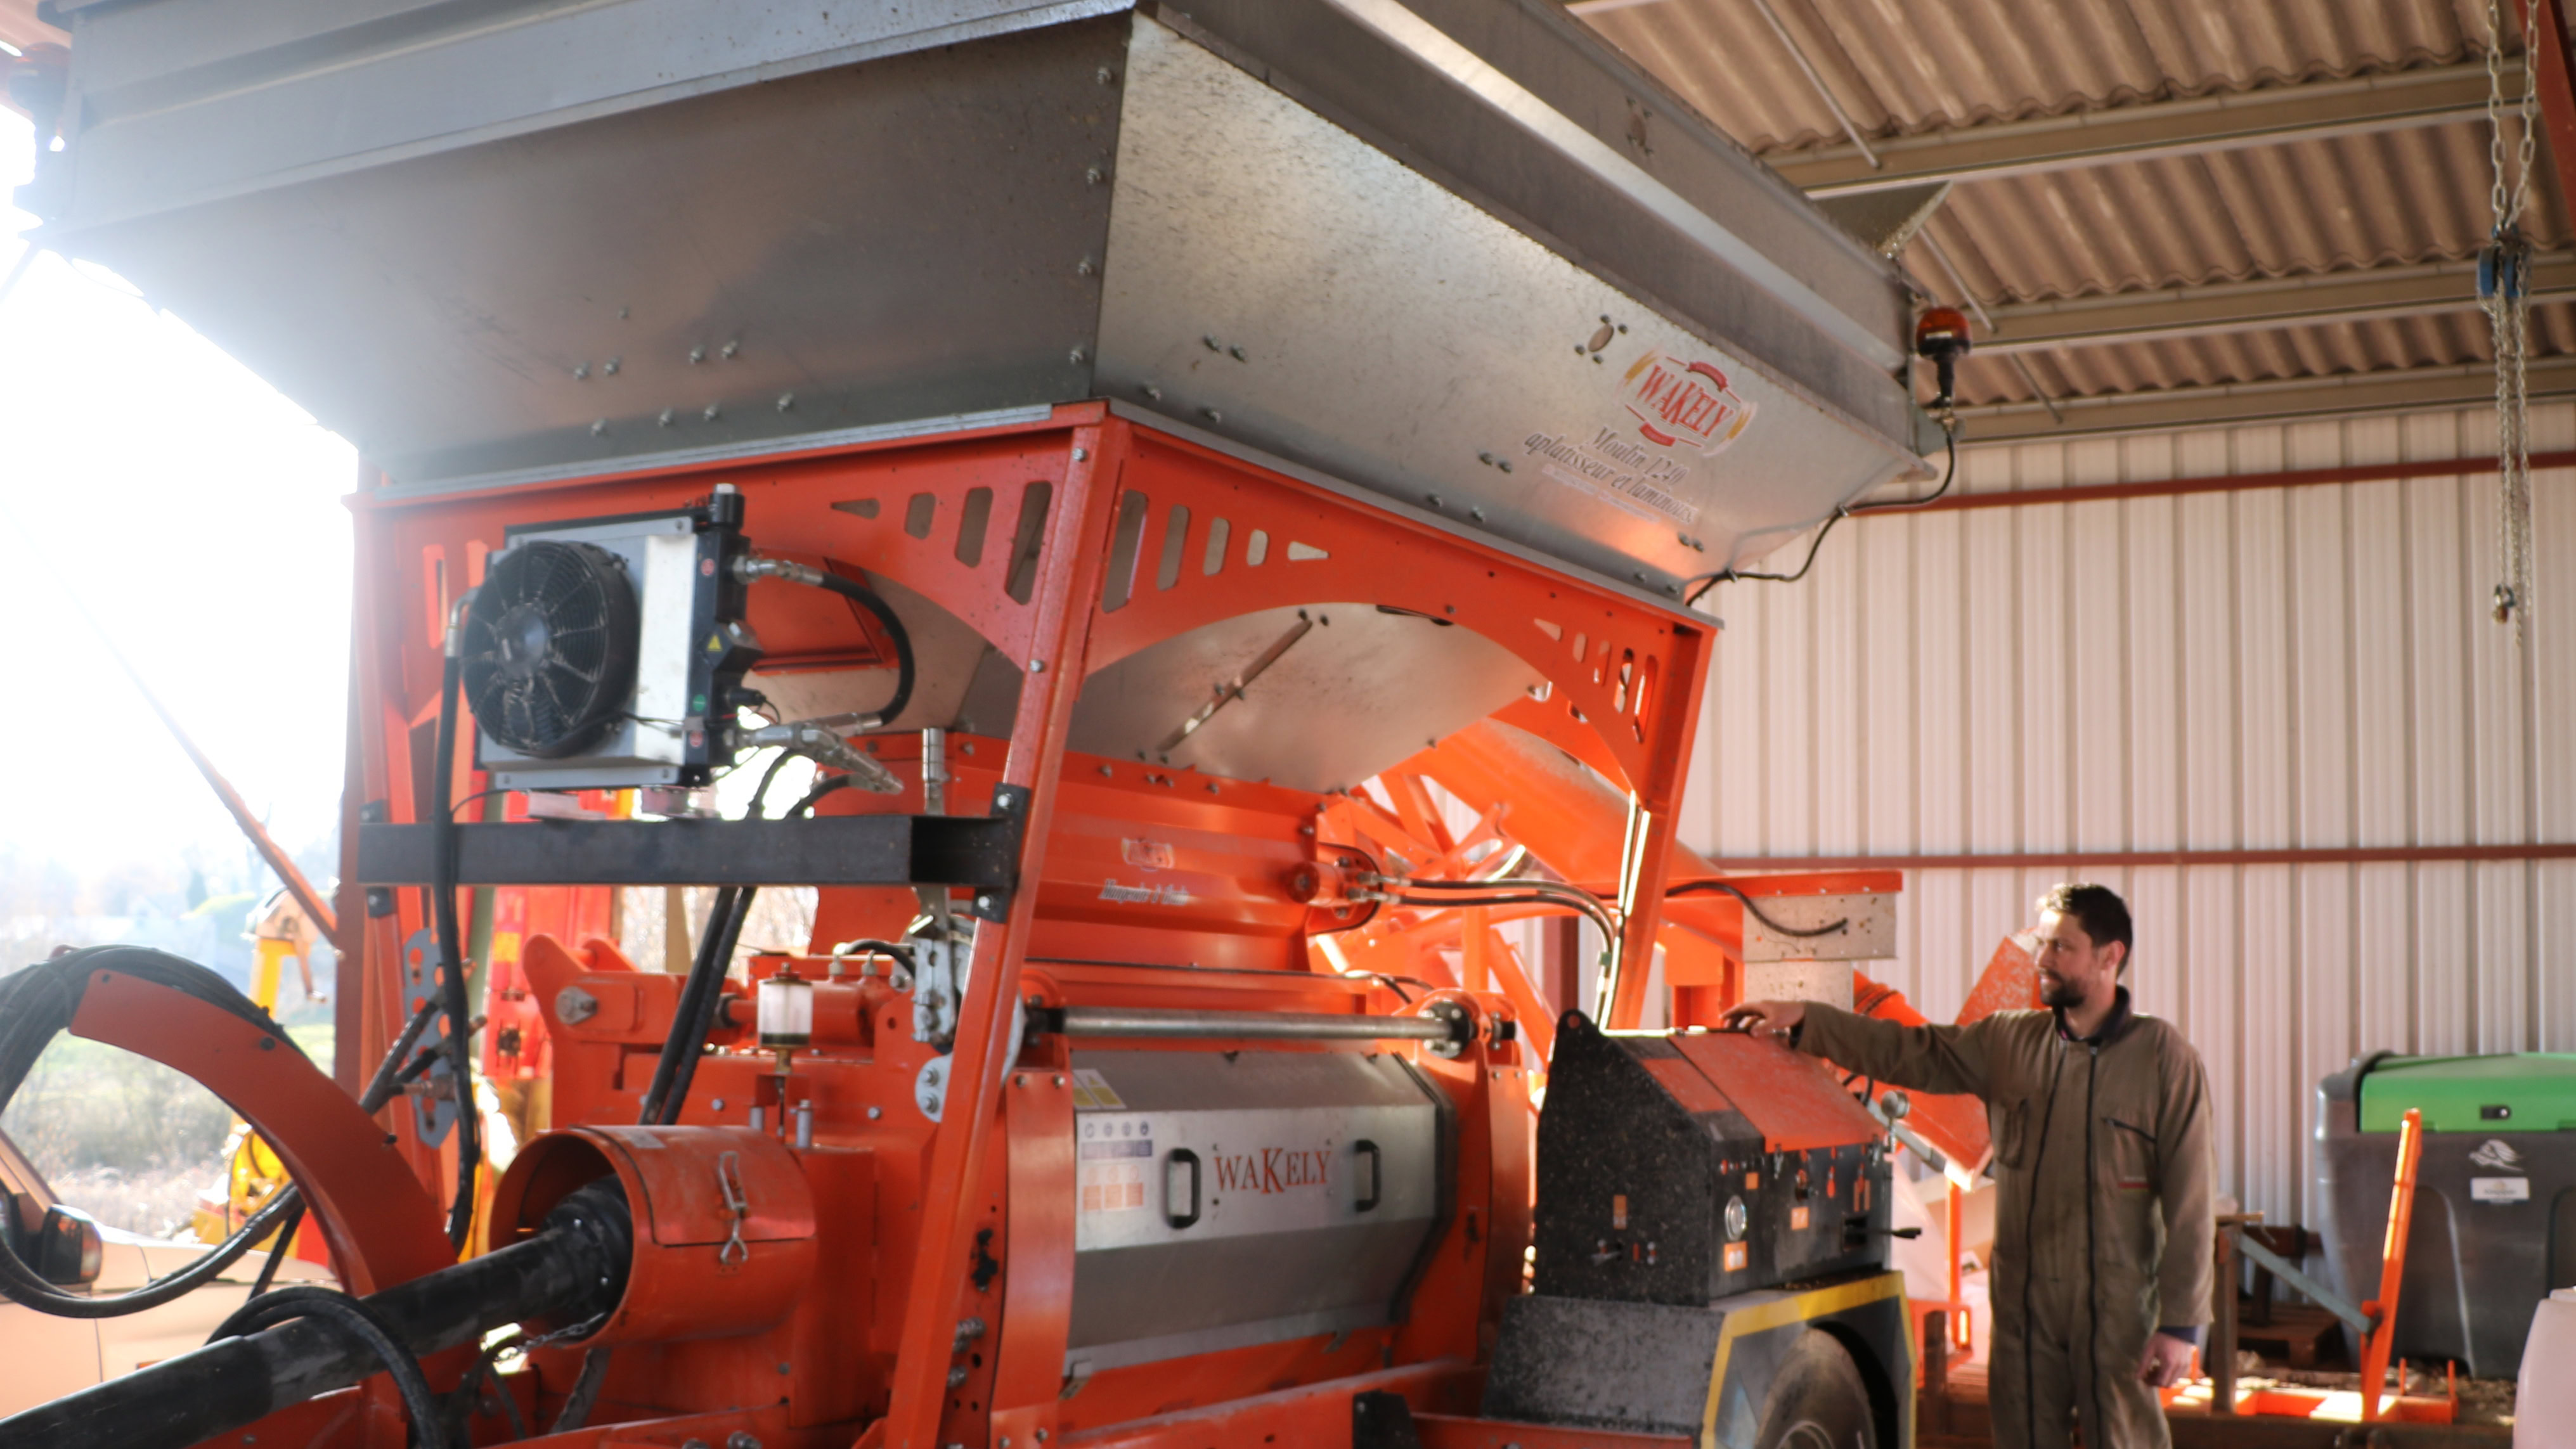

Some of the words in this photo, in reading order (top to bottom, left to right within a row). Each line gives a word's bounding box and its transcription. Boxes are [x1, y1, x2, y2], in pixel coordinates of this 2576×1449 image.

[1636, 364, 1735, 439] WAKELY
[1523, 432, 1614, 480] aplatisseur
[1612, 473, 1633, 490] et
[1589, 426, 1648, 470] Moulin
[1215, 1148, 1331, 1194] WAKELY
